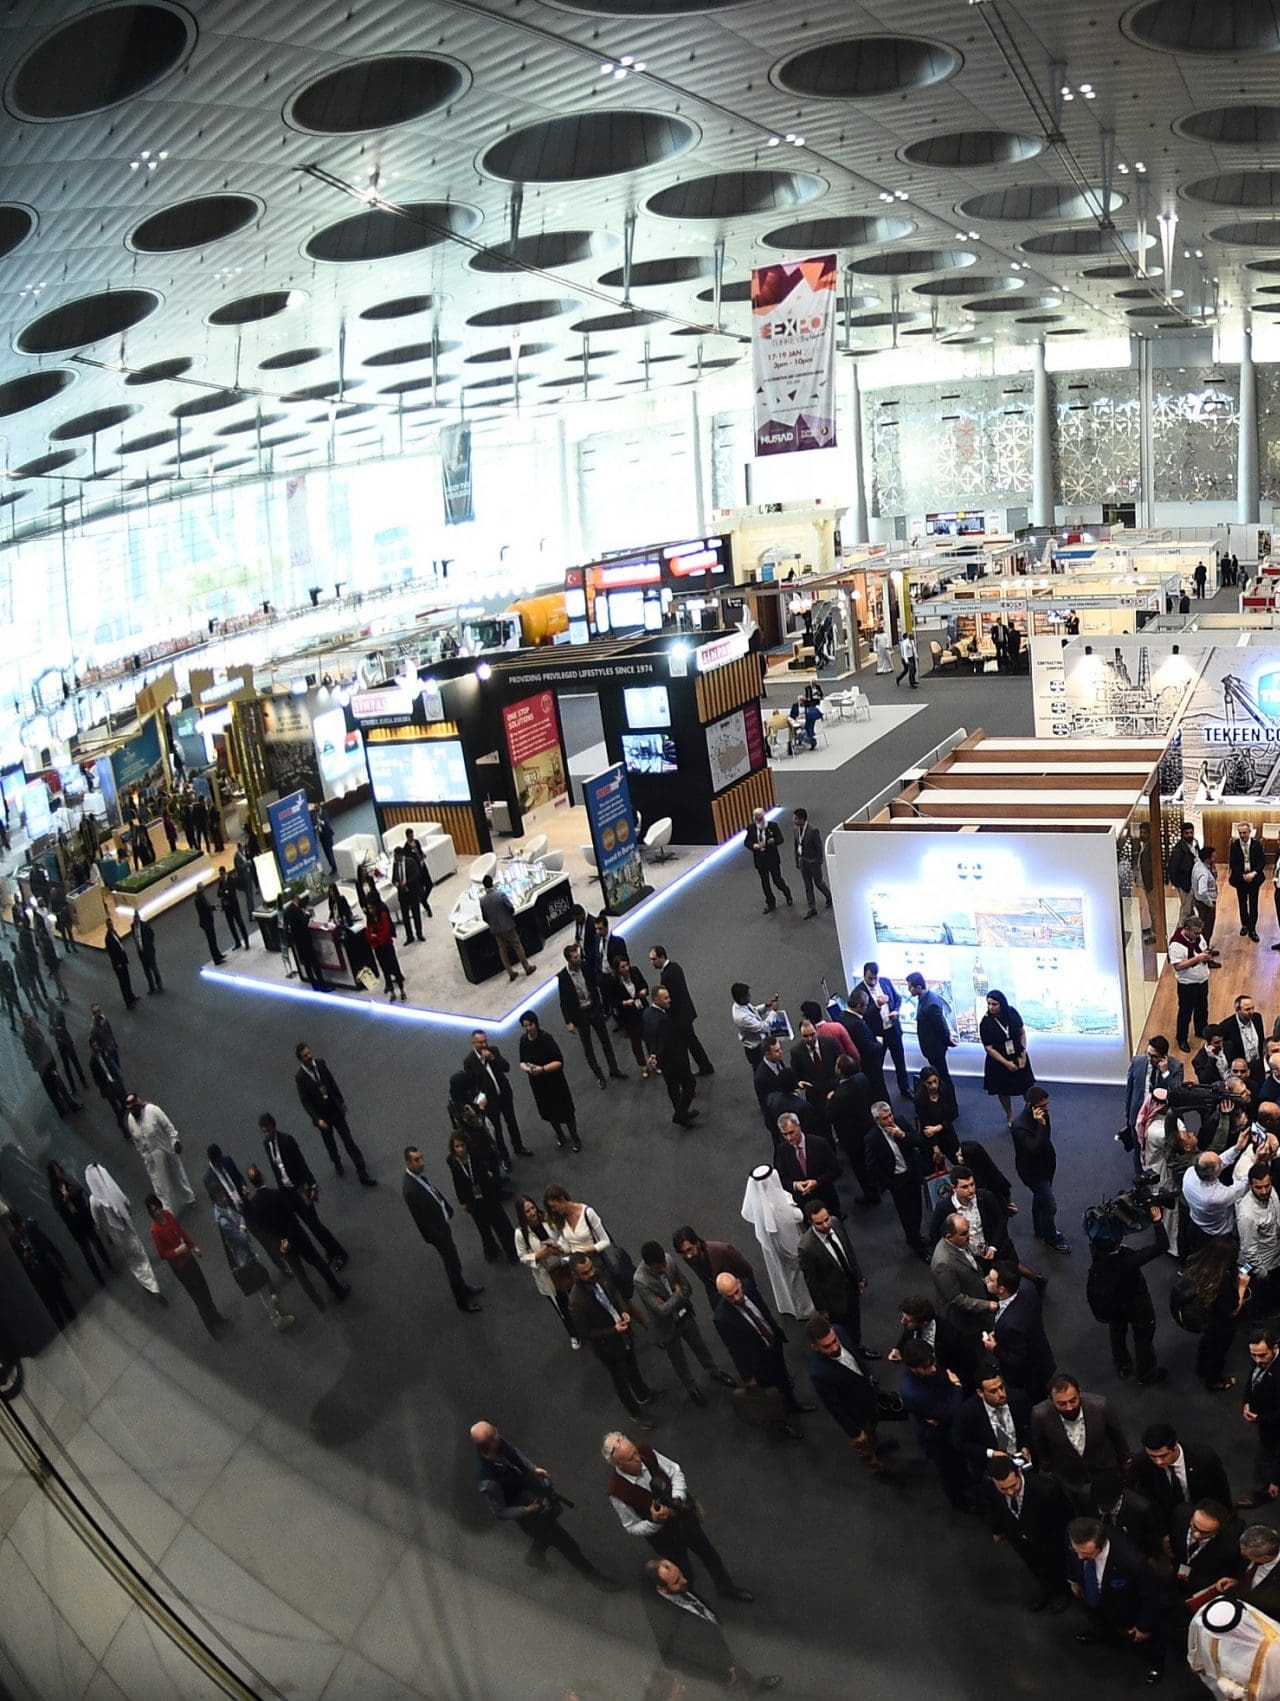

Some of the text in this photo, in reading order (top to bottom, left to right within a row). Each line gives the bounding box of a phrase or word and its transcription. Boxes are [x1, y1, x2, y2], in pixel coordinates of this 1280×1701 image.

[771, 316, 825, 338] EXPO
[579, 668, 613, 678] LIFESTYLES
[615, 666, 635, 675] SINCE
[637, 664, 653, 673] 1974
[1204, 727, 1260, 742] TEKFEN
